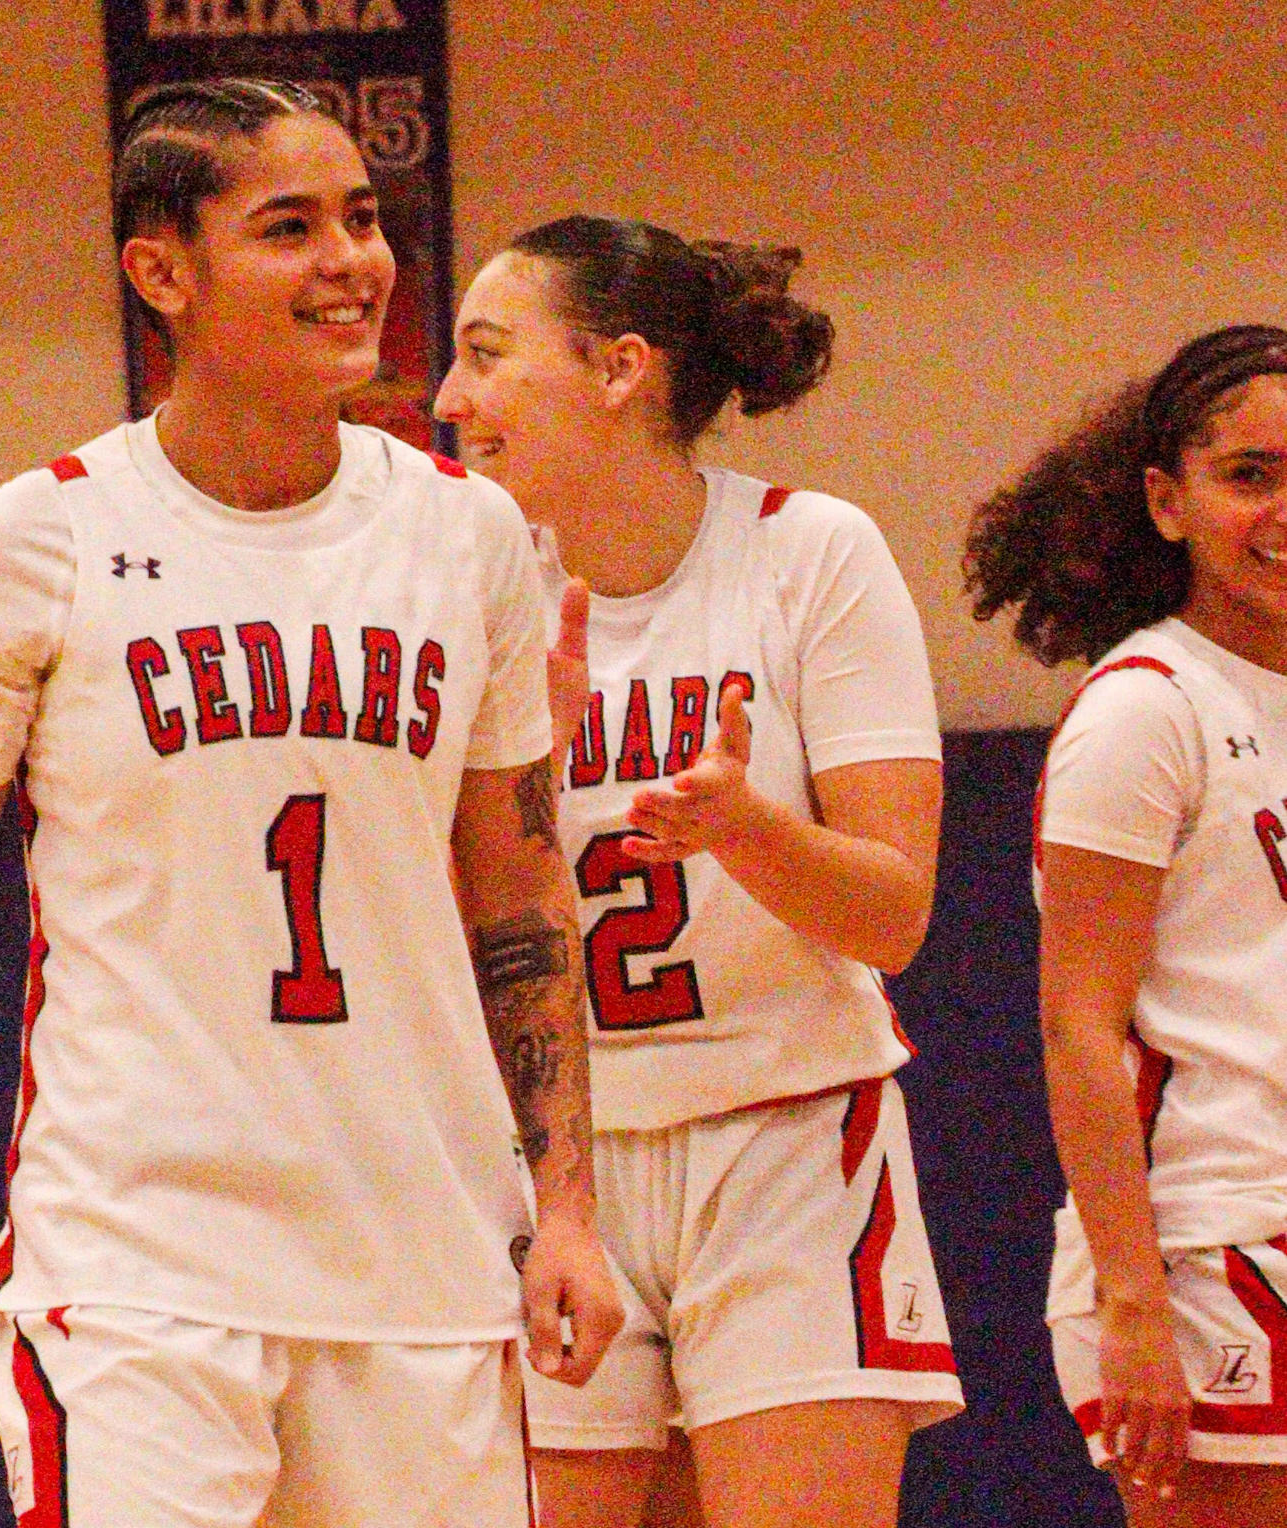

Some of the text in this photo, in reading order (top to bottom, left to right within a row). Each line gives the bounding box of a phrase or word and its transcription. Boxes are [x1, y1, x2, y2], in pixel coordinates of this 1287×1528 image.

[125, 620, 447, 761] CEDARS
[566, 669, 756, 791] DAR
[265, 791, 350, 1025] 1
[574, 828, 705, 1032] 2
